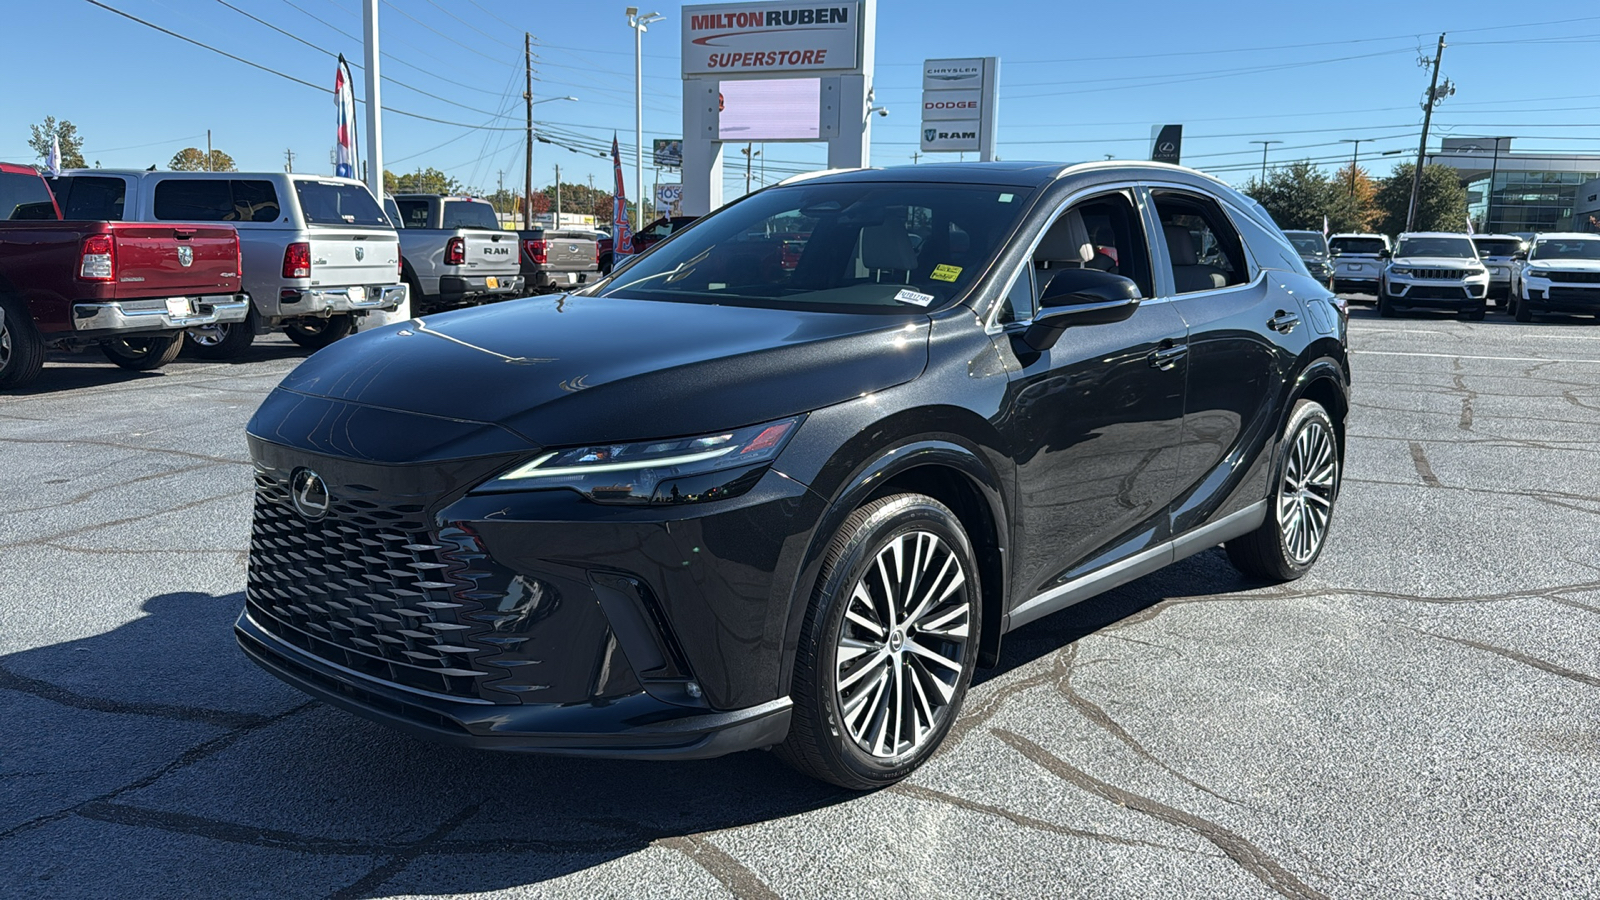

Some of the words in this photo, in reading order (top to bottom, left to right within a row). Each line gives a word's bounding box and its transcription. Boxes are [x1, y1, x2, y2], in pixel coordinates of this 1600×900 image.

[691, 12, 764, 30] MILTON
[766, 8, 848, 27] RUBEN
[707, 49, 828, 68] SUPERSTORE
[483, 247, 509, 255] RAM
